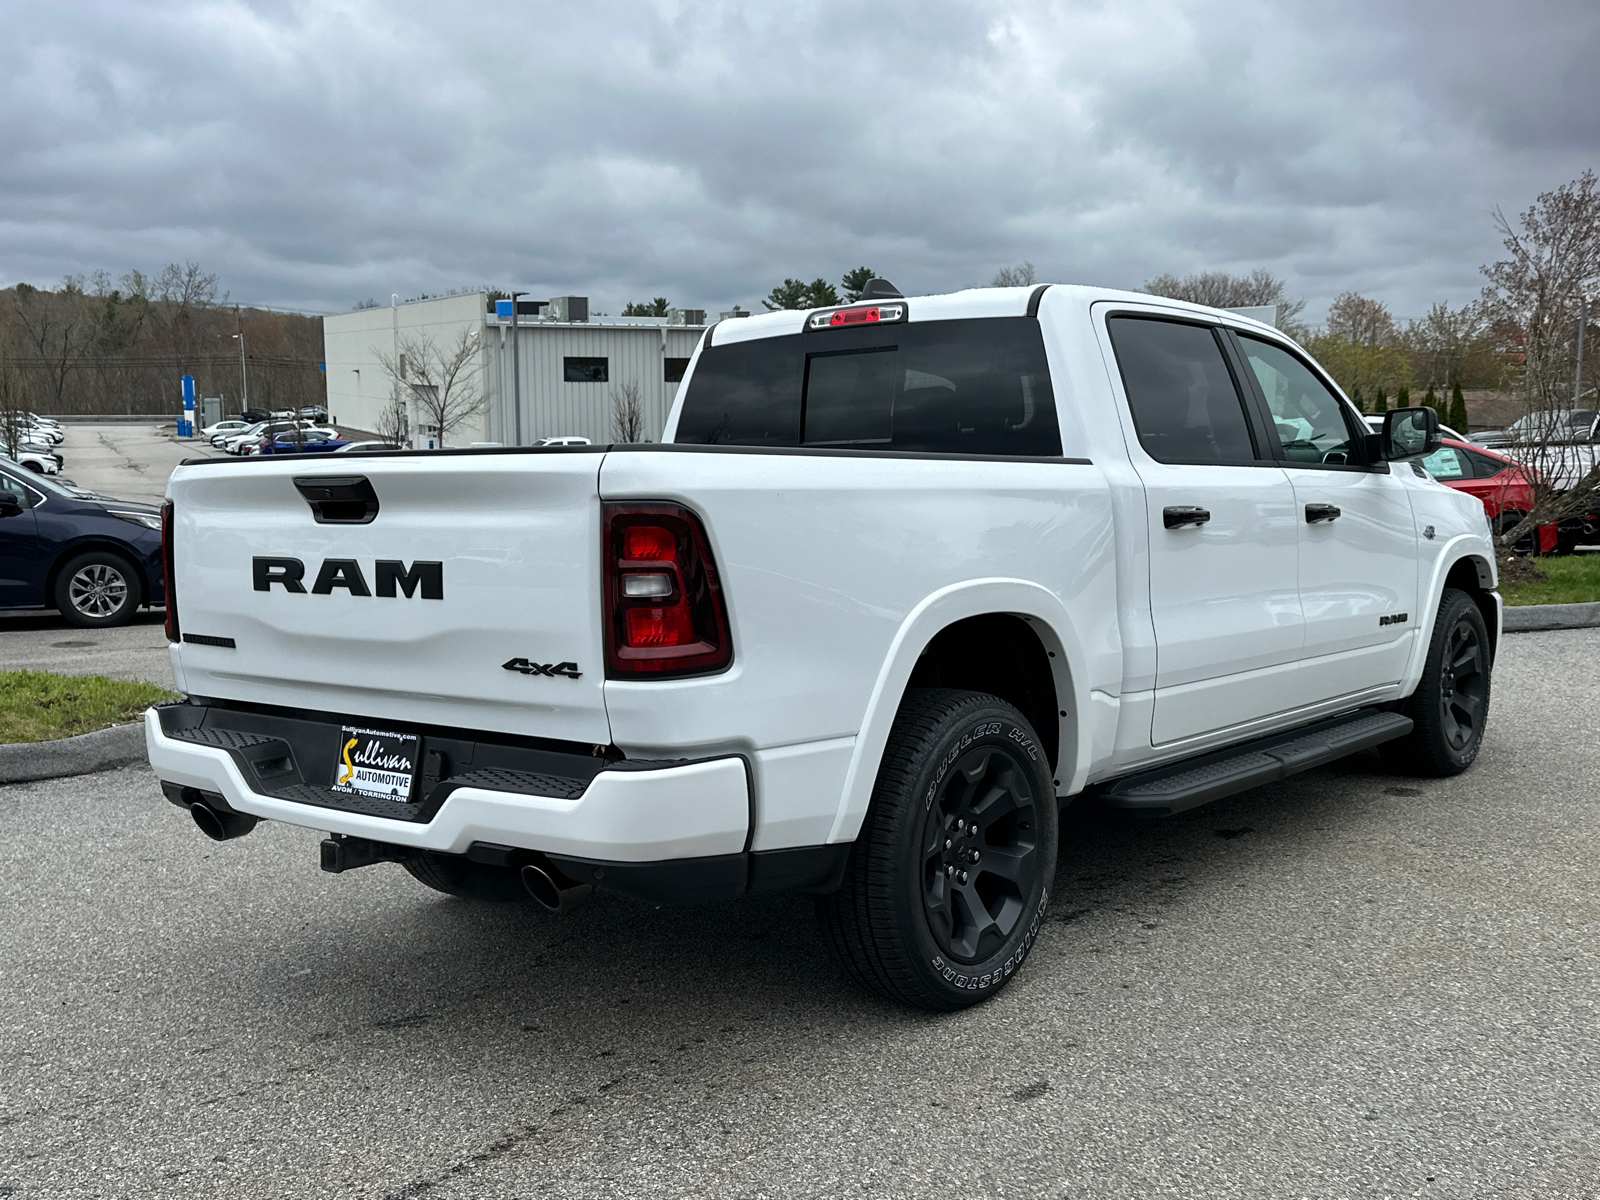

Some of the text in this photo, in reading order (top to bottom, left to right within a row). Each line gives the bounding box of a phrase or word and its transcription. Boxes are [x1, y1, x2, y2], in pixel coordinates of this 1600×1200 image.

[253, 556, 443, 600] RAM
[1379, 613, 1408, 626] RAM
[501, 657, 583, 679] 4x4
[341, 725, 417, 740] SullivanAutomotive.com
[339, 738, 411, 783] Sullivan
[926, 723, 1037, 811] DUELER H/L
[356, 770, 409, 788] AUTOMOTIVE
[331, 785, 352, 794] AVON
[359, 789, 407, 803] TORRINGTON
[932, 887, 1049, 990] BRIDGESTONE
